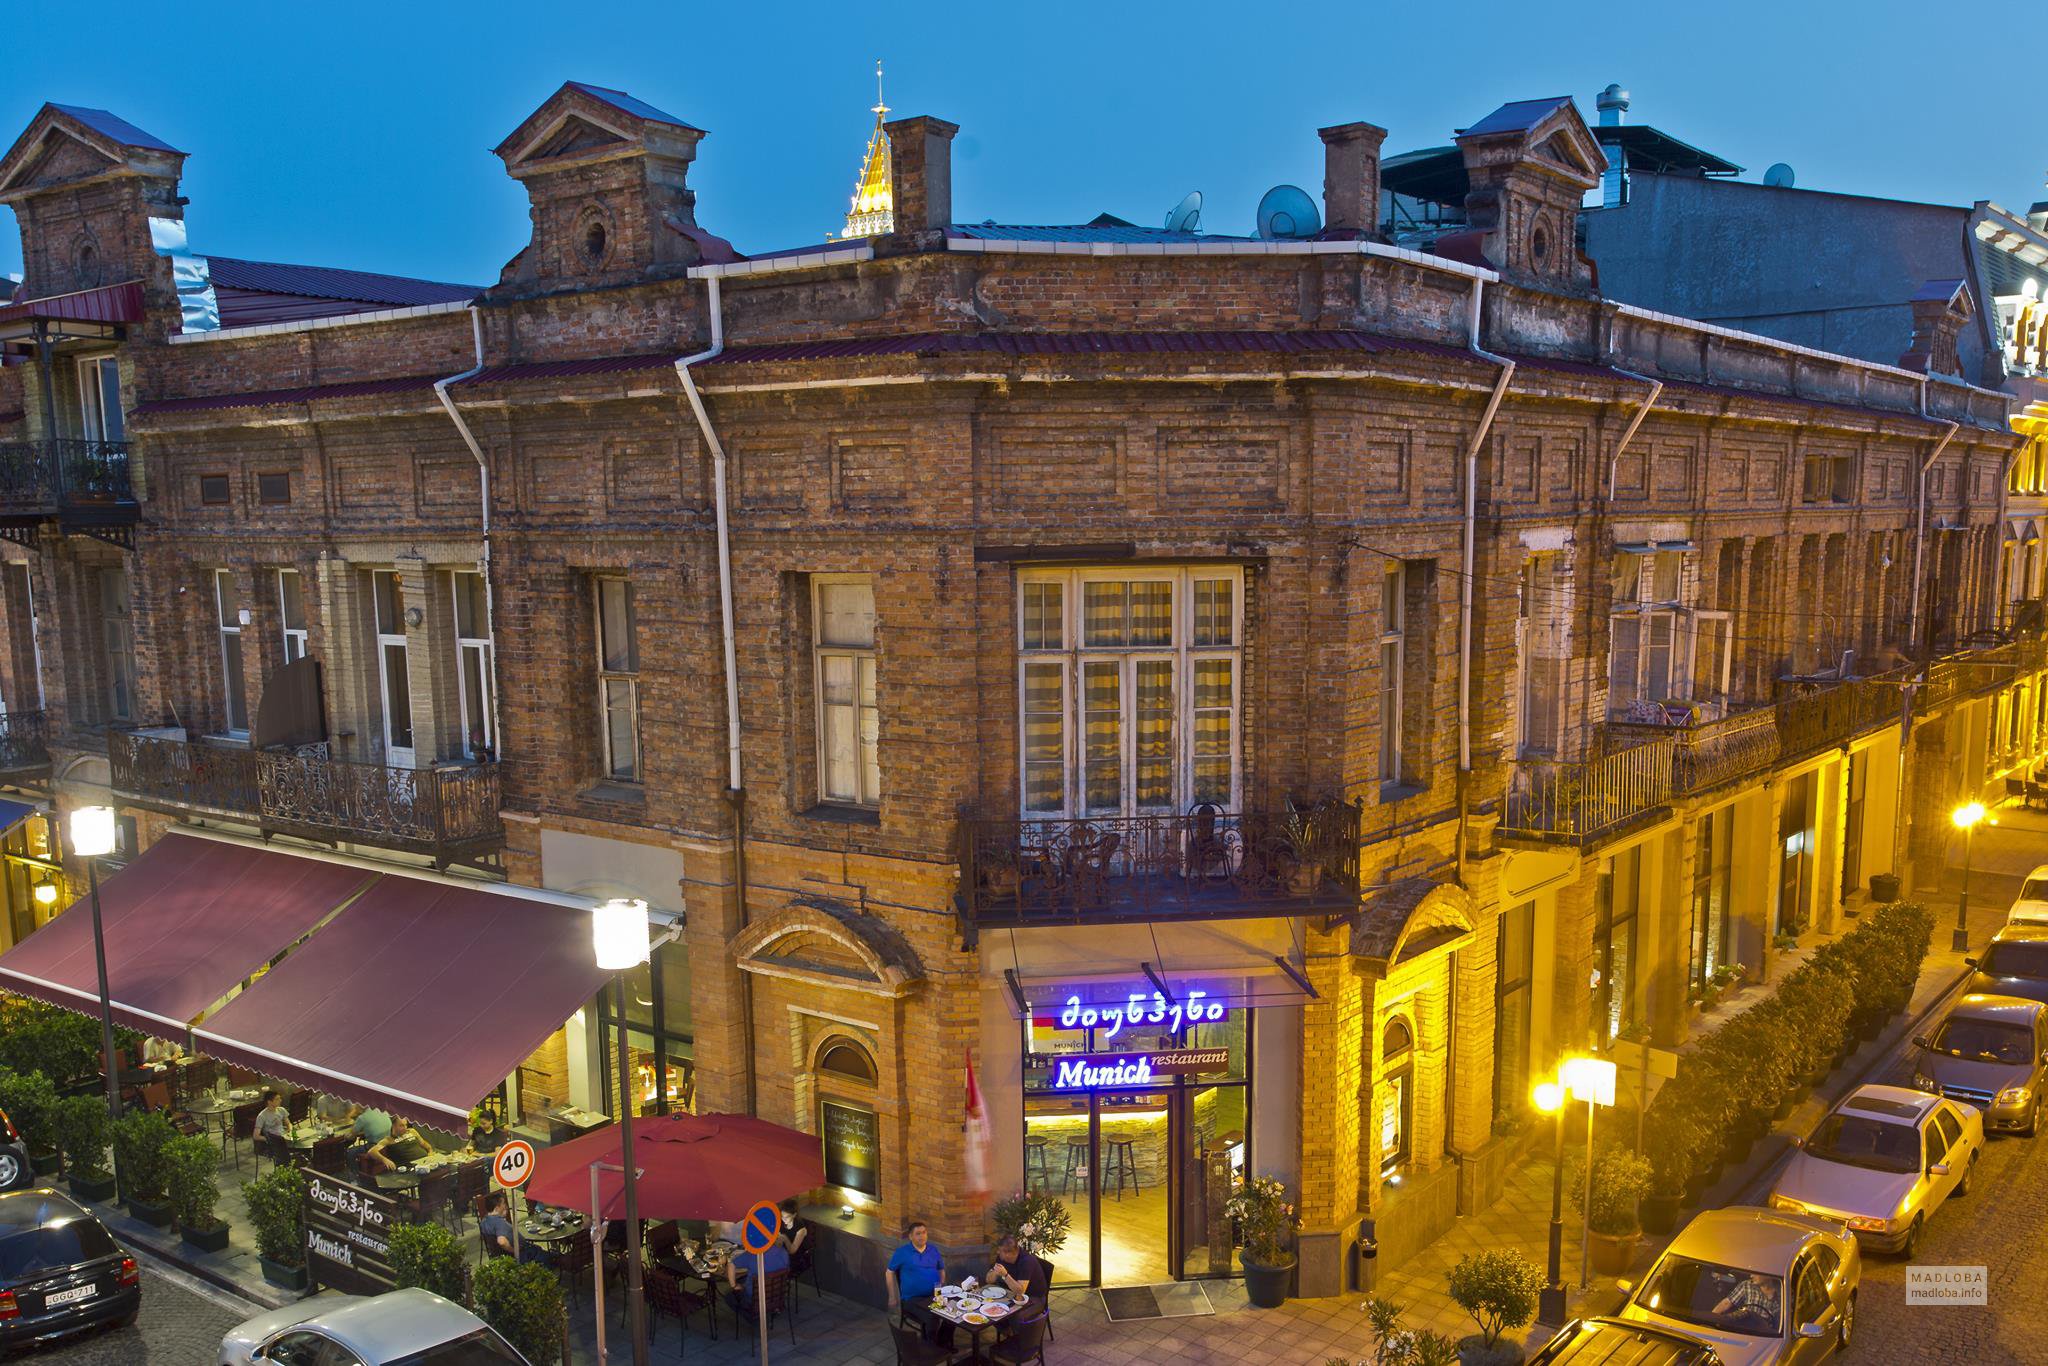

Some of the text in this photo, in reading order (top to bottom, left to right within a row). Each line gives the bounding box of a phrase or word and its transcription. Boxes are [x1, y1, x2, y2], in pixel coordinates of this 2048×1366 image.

[1056, 1051, 1228, 1089] Munich restaurant
[502, 1152, 525, 1171] 40
[308, 1230, 389, 1265] Munich restauran
